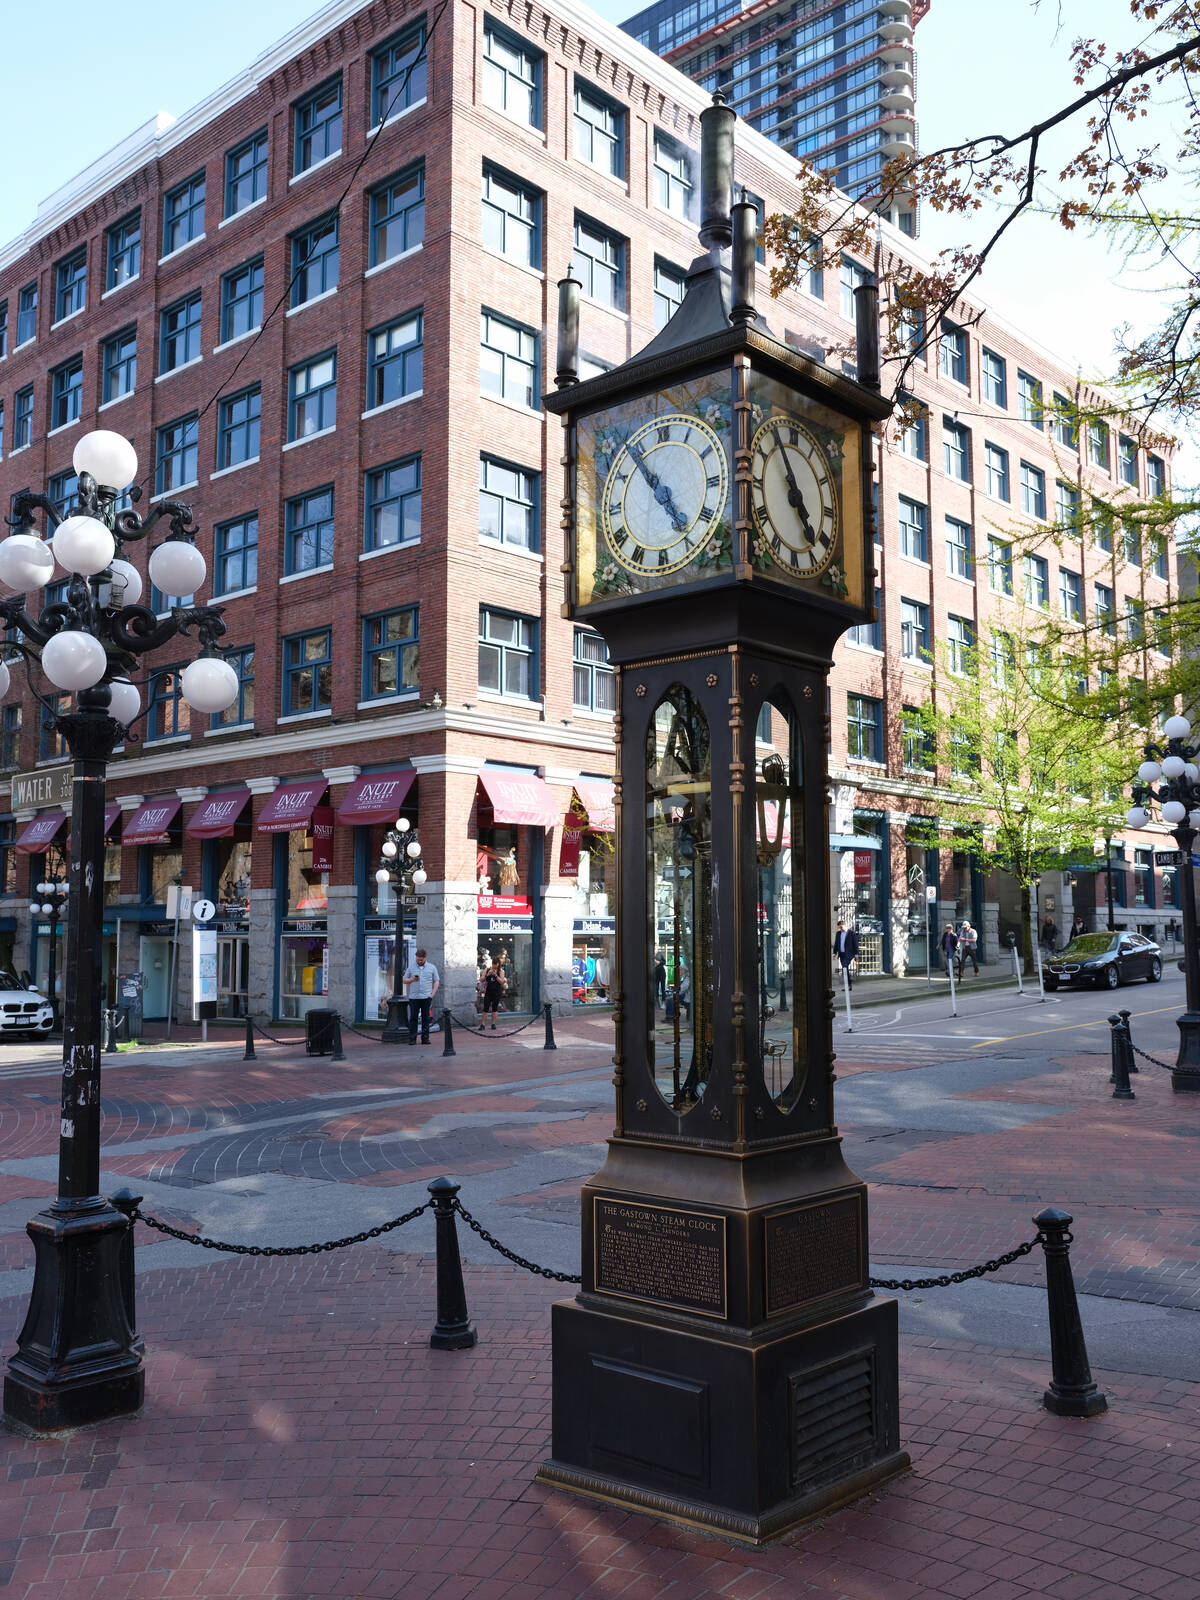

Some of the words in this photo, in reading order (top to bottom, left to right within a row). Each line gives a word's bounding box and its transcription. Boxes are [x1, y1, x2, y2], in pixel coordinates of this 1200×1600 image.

[18, 777, 52, 804] WATER
[60, 785, 73, 798] 300
[359, 781, 400, 797] INUIT
[277, 791, 312, 806] INUIT
[205, 800, 237, 815] INUIT
[140, 808, 170, 822] INUIT
[32, 821, 57, 834] INUIT
[314, 825, 333, 834] INUIT
[603, 1206, 617, 1215] THE
[619, 1208, 658, 1222] GASTOWN
[660, 1215, 685, 1227] STEAM
[688, 1219, 716, 1232] CLOCK
[626, 1222, 652, 1231] RAYMOND
